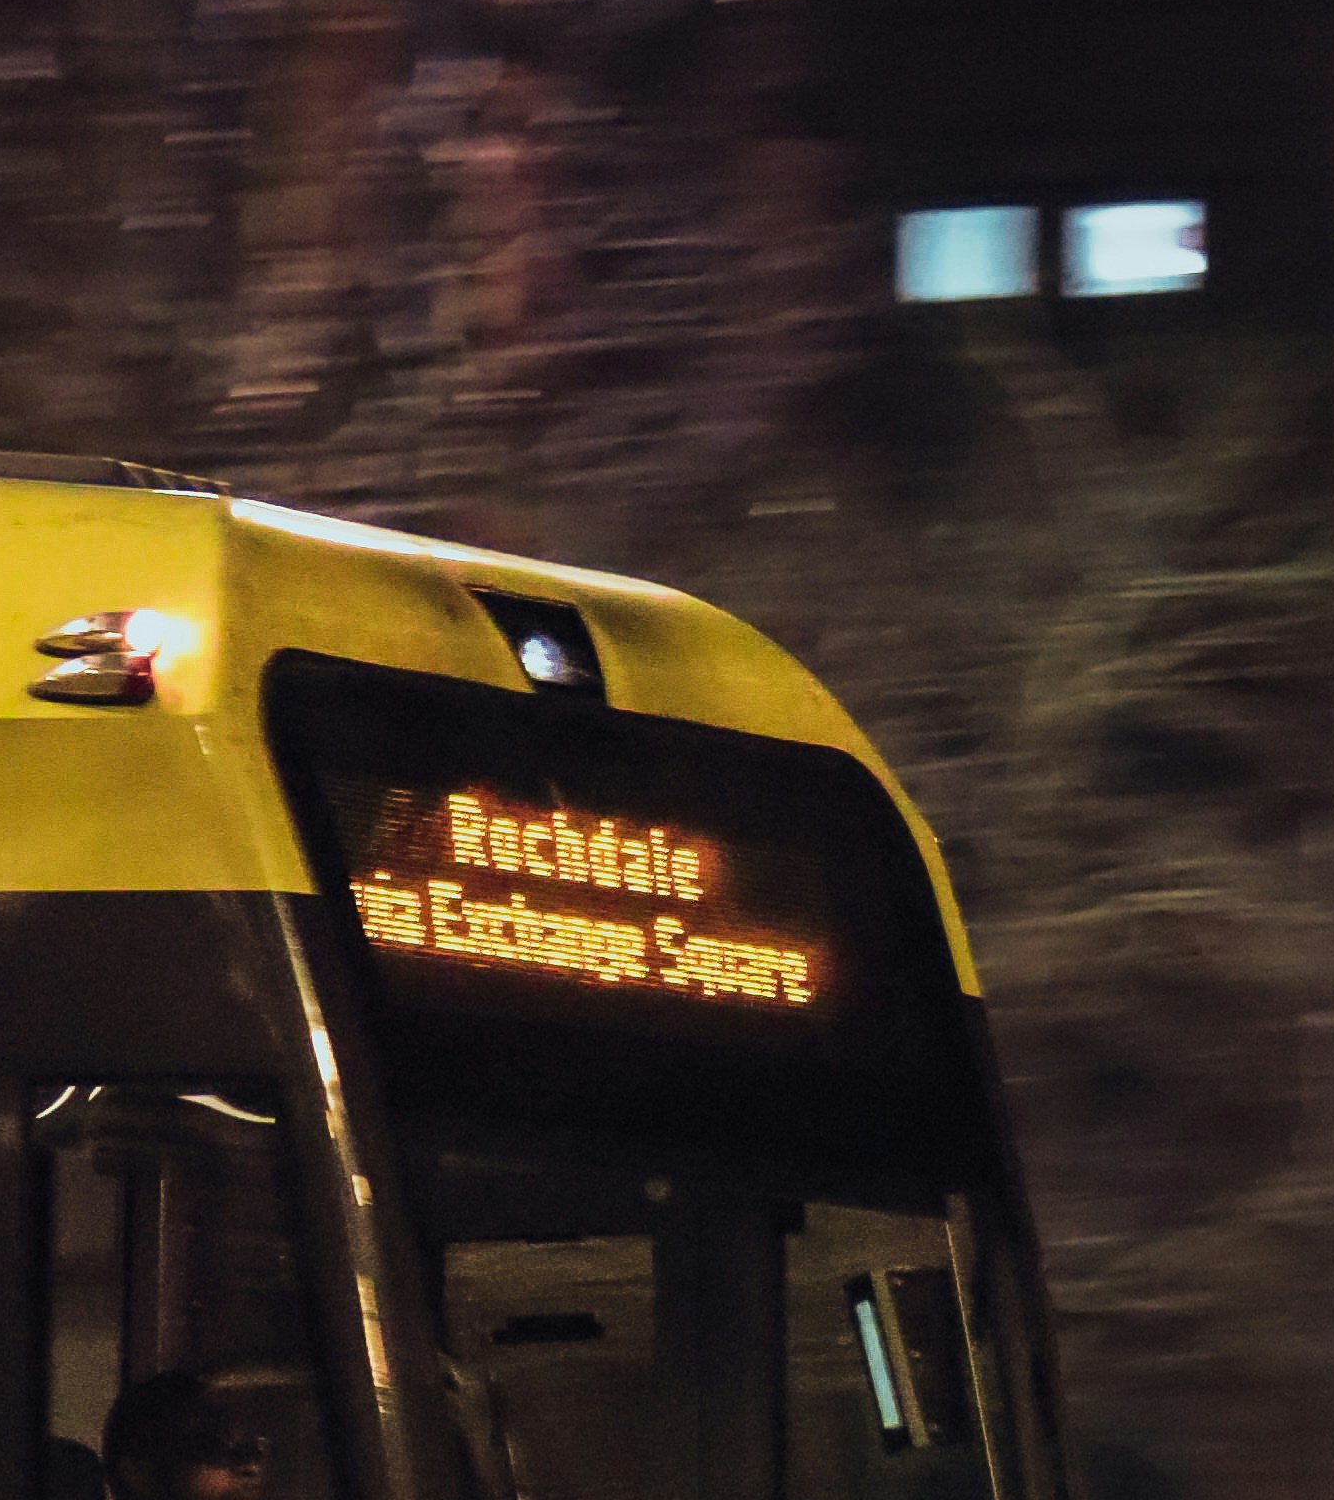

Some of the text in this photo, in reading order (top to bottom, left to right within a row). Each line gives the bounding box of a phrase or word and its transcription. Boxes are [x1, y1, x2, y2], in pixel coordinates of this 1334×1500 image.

[448, 793, 703, 900] Rochdale
[428, 879, 649, 981] Exchange
[653, 916, 812, 1003] Square
